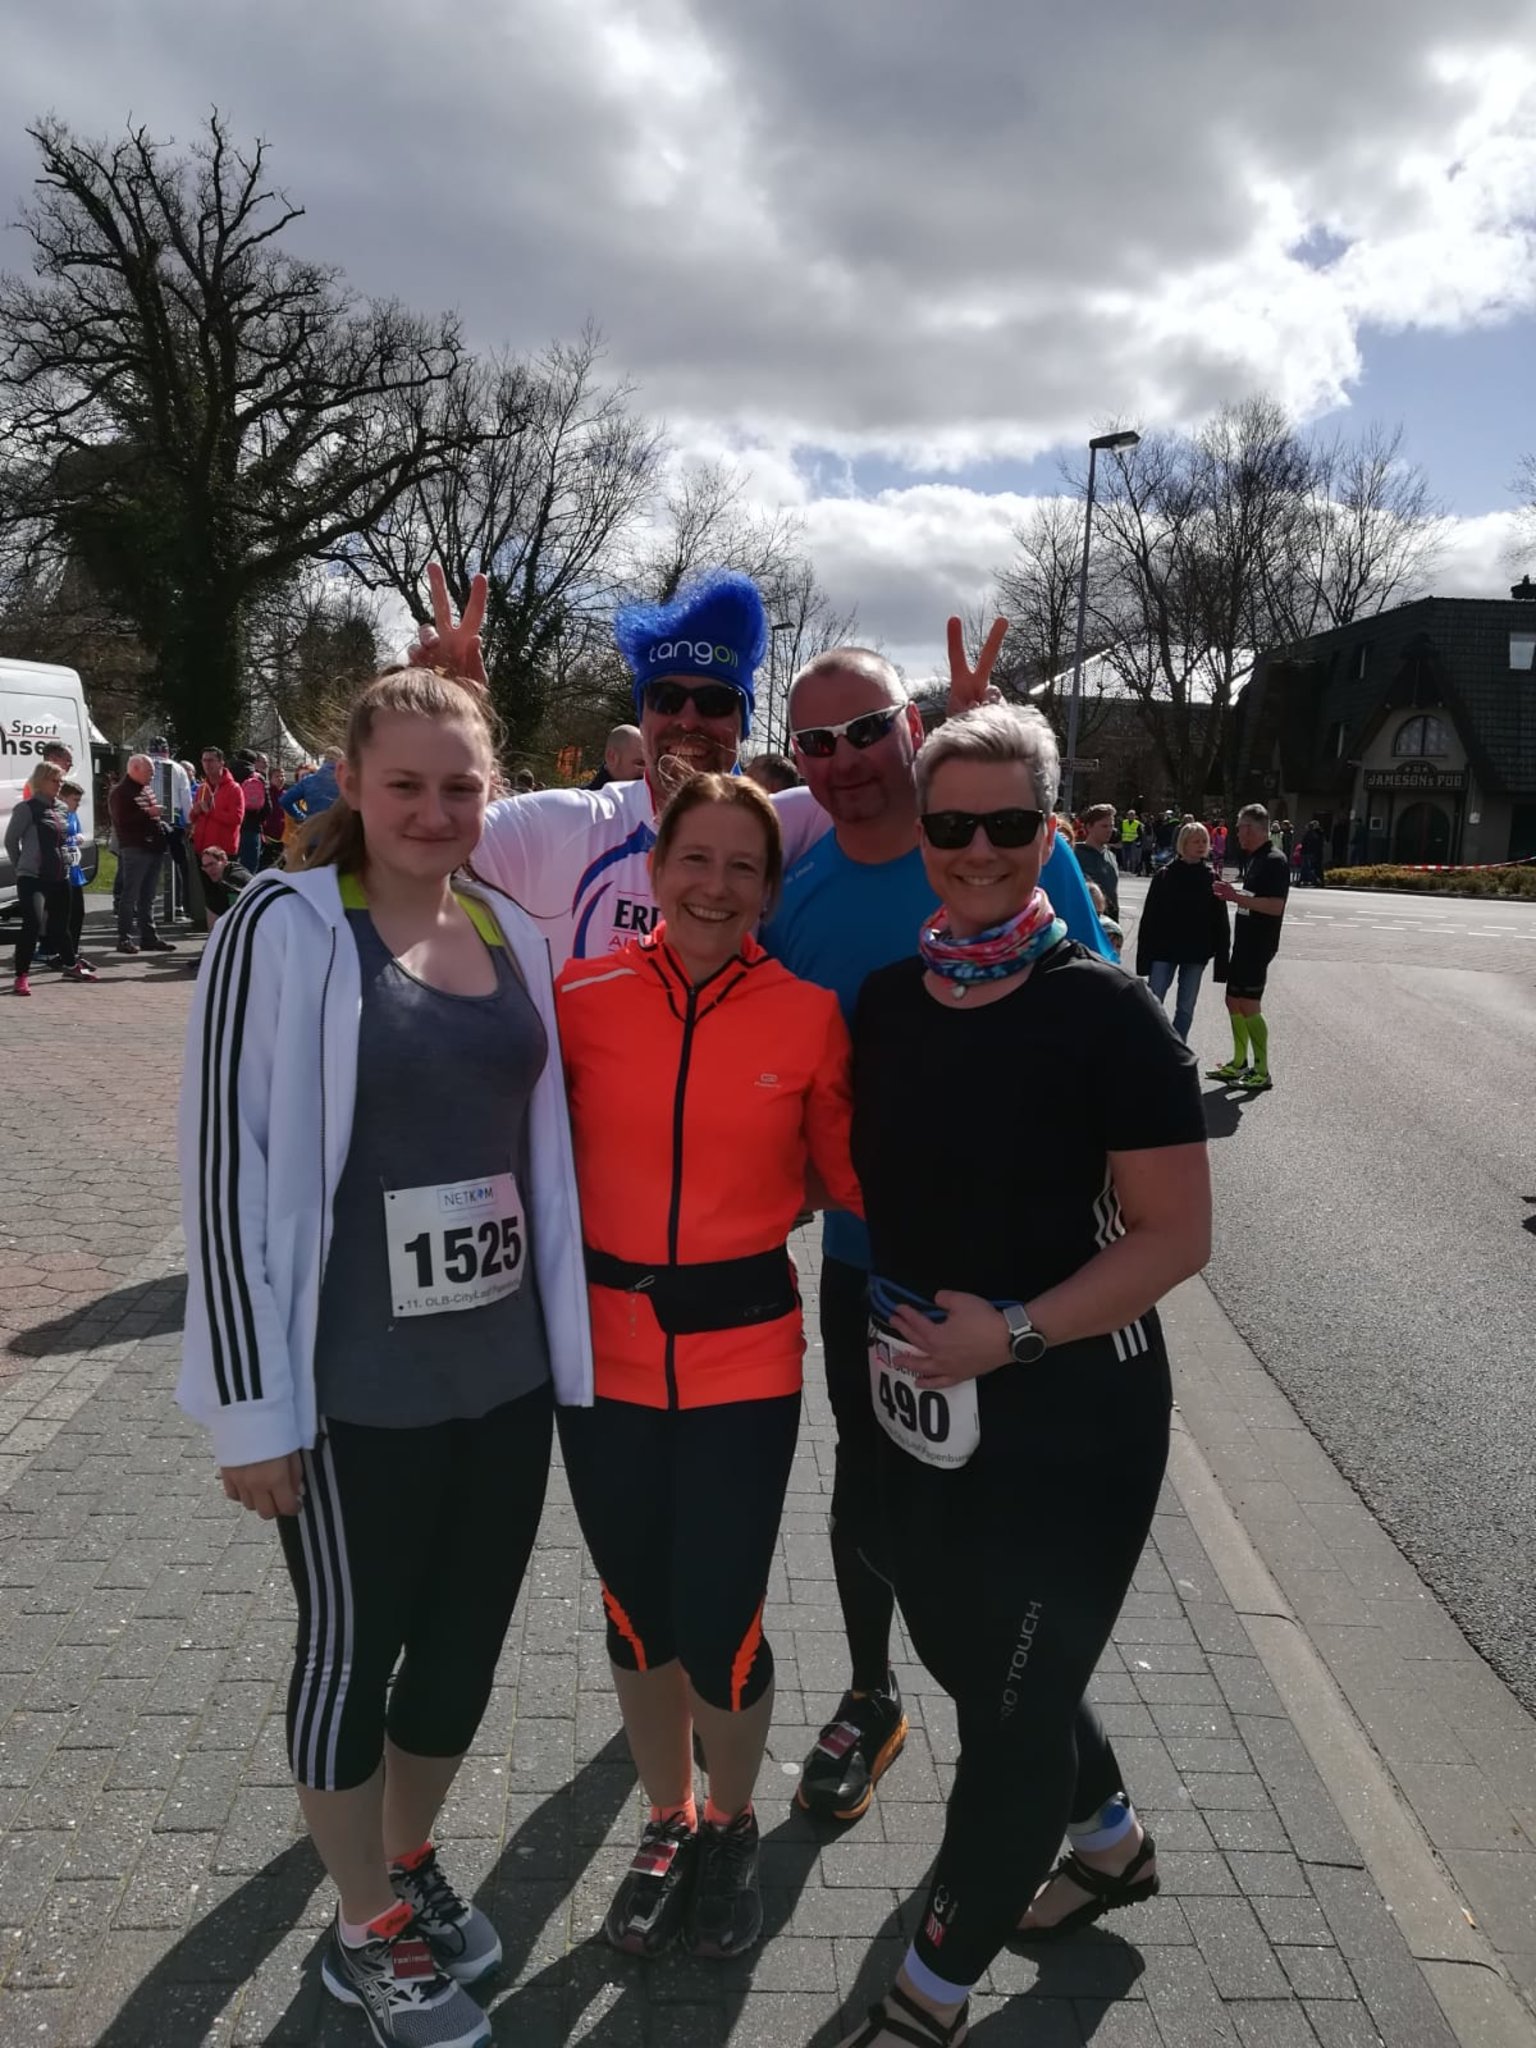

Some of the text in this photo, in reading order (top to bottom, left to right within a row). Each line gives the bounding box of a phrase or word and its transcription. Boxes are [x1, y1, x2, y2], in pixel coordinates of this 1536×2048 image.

[649, 640, 731, 665] tango
[11, 719, 58, 737] Sport
[404, 1216, 521, 1288] 1525
[879, 1371, 950, 1443] 490
[1006, 1600, 1042, 1682] TOUCH
